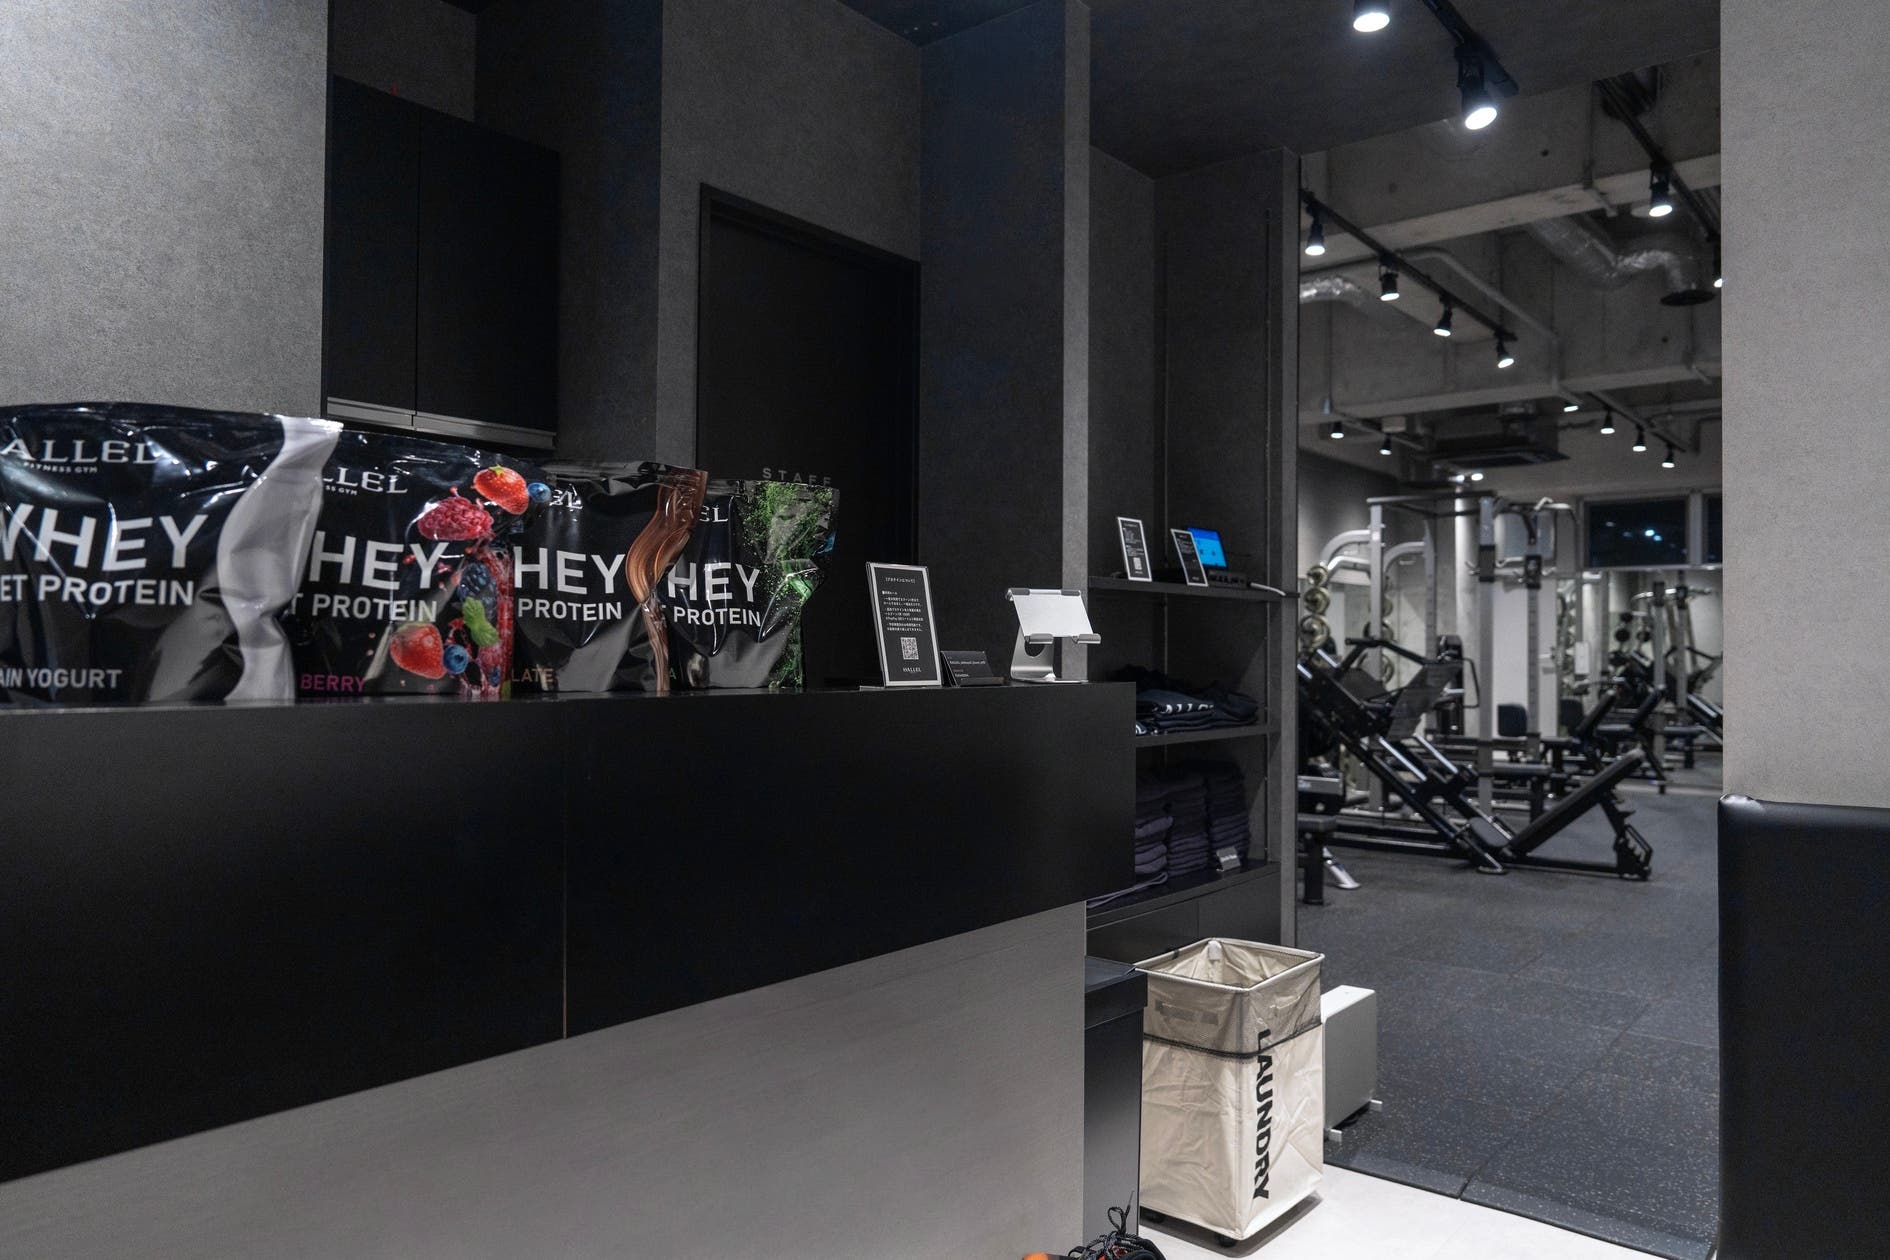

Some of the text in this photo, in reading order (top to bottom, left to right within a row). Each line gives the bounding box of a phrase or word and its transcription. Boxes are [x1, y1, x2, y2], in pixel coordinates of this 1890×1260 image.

[23, 462, 72, 473] FITNESS
[762, 467, 832, 487] STAFF
[323, 466, 408, 493] LEL
[38, 574, 194, 606] PROTEIN
[312, 593, 437, 622] PROTEIN
[518, 598, 622, 621] PROTEIN
[673, 606, 760, 627] PROTEIN
[26, 667, 122, 688] YOGURT
[301, 674, 368, 693] BERRY
[1253, 1028, 1274, 1200] LAUNDRY
